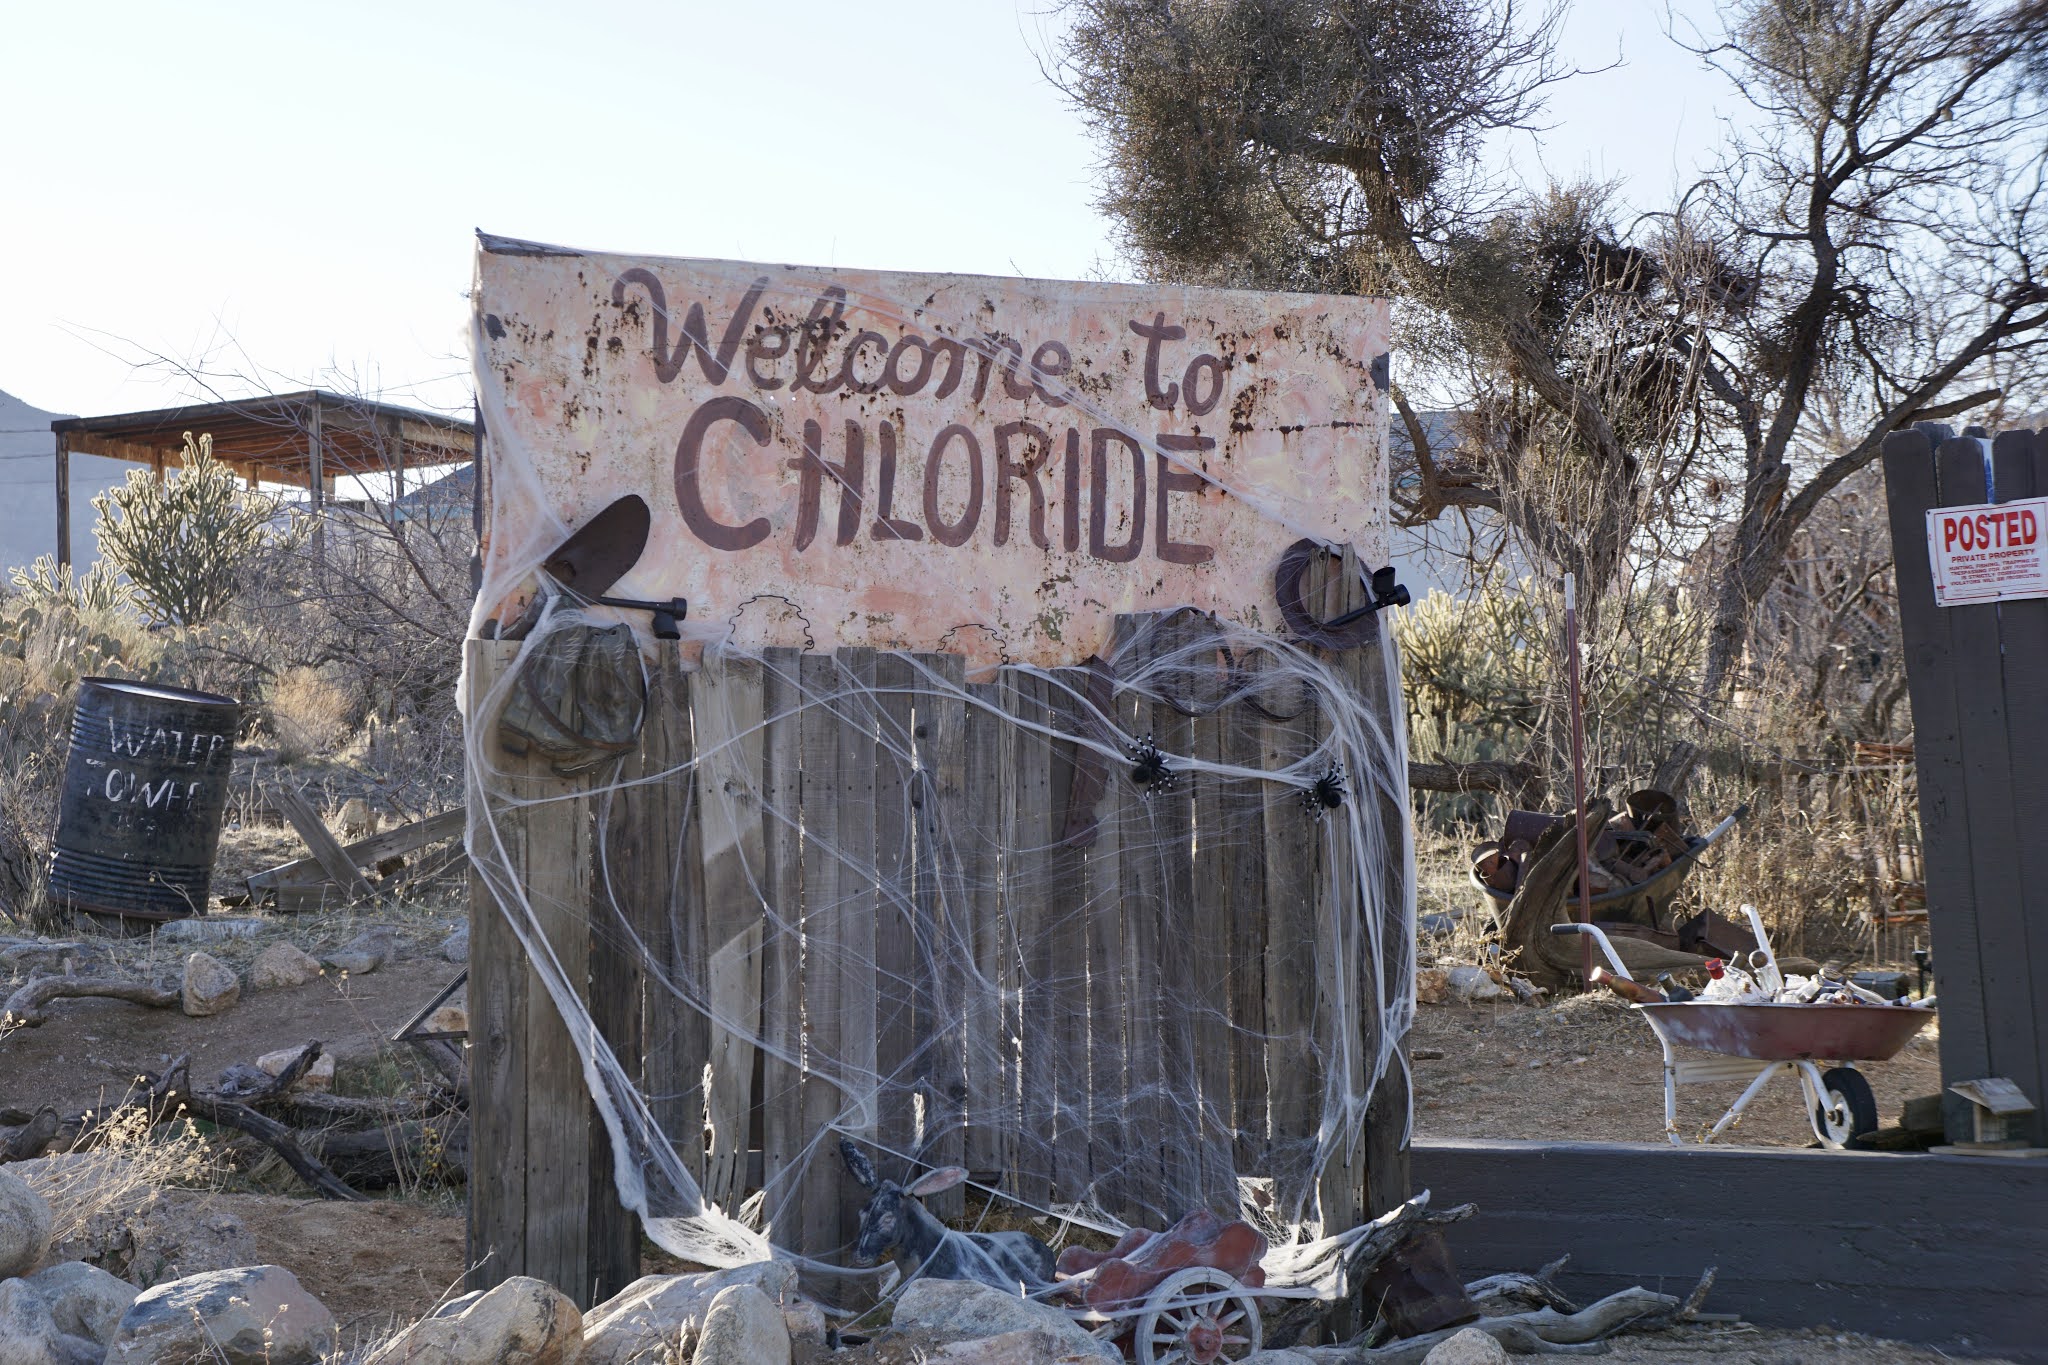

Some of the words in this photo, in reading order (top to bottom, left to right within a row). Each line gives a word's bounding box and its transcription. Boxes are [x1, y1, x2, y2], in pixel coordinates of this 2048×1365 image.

[612, 267, 1077, 407] Welcome
[1128, 311, 1225, 415] to
[674, 395, 1216, 564] CHLORIDE
[1943, 509, 2037, 553] POSTED
[1951, 553, 1986, 563] PRIVATE
[1988, 548, 2036, 560] PROPERTY
[108, 716, 225, 768] WATER
